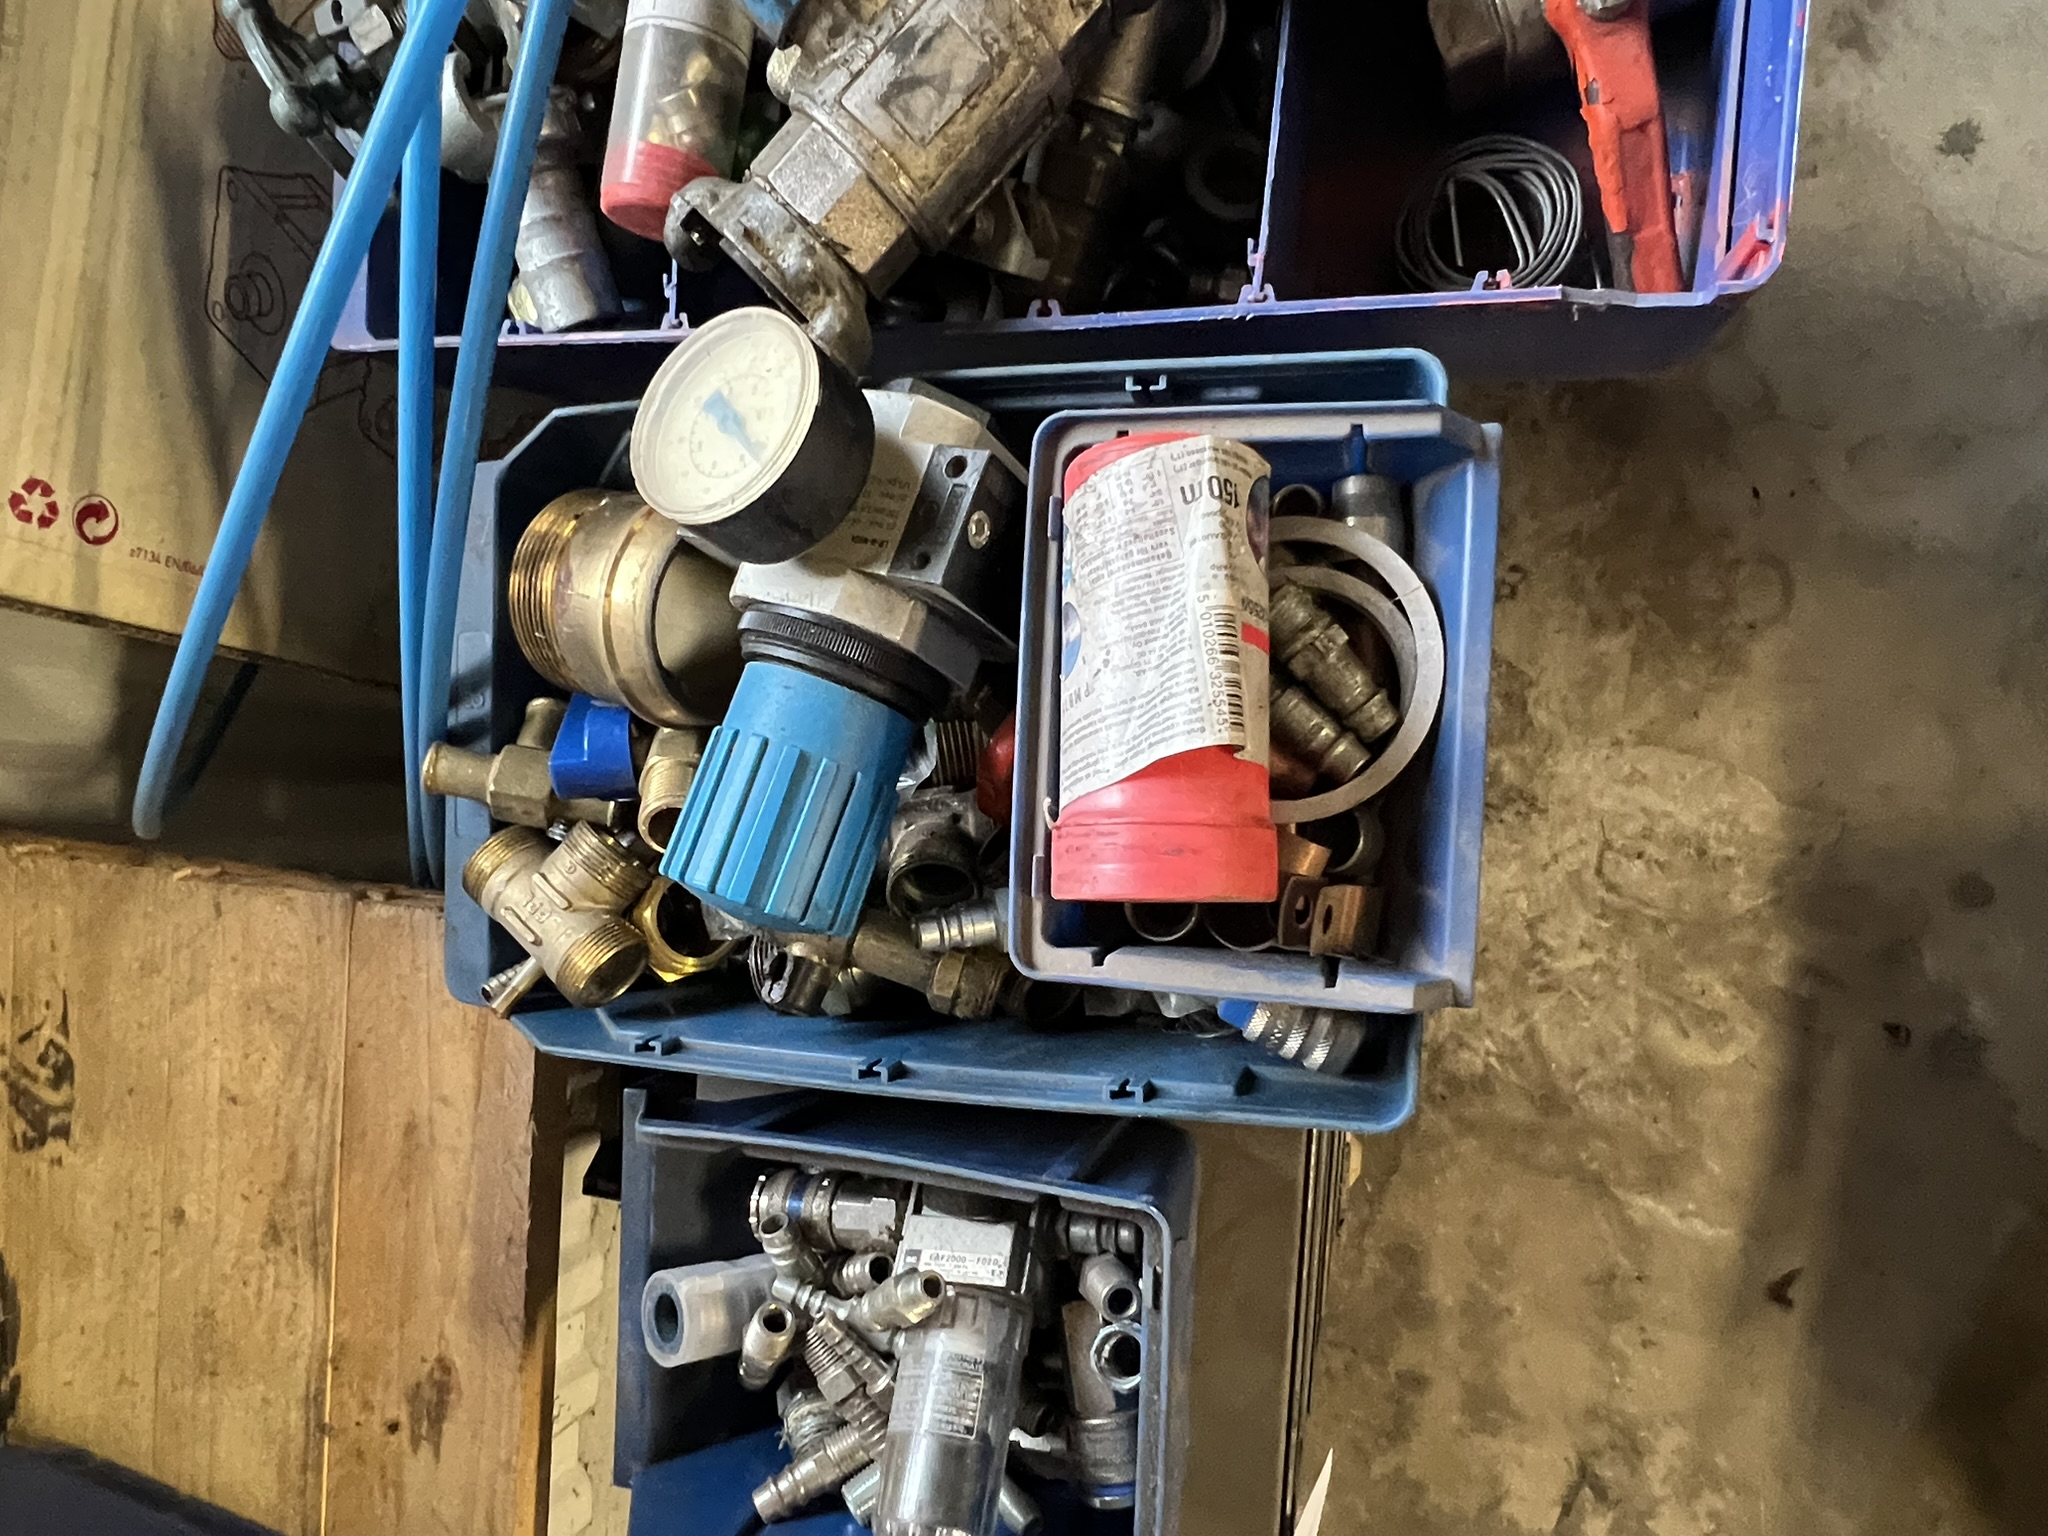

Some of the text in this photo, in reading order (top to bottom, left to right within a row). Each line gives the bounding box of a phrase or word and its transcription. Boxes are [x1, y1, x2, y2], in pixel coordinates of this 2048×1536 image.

[1180, 480, 1203, 505] m
[1208, 475, 1239, 508] 150
[1197, 594, 1228, 726] 5 010266 325545
